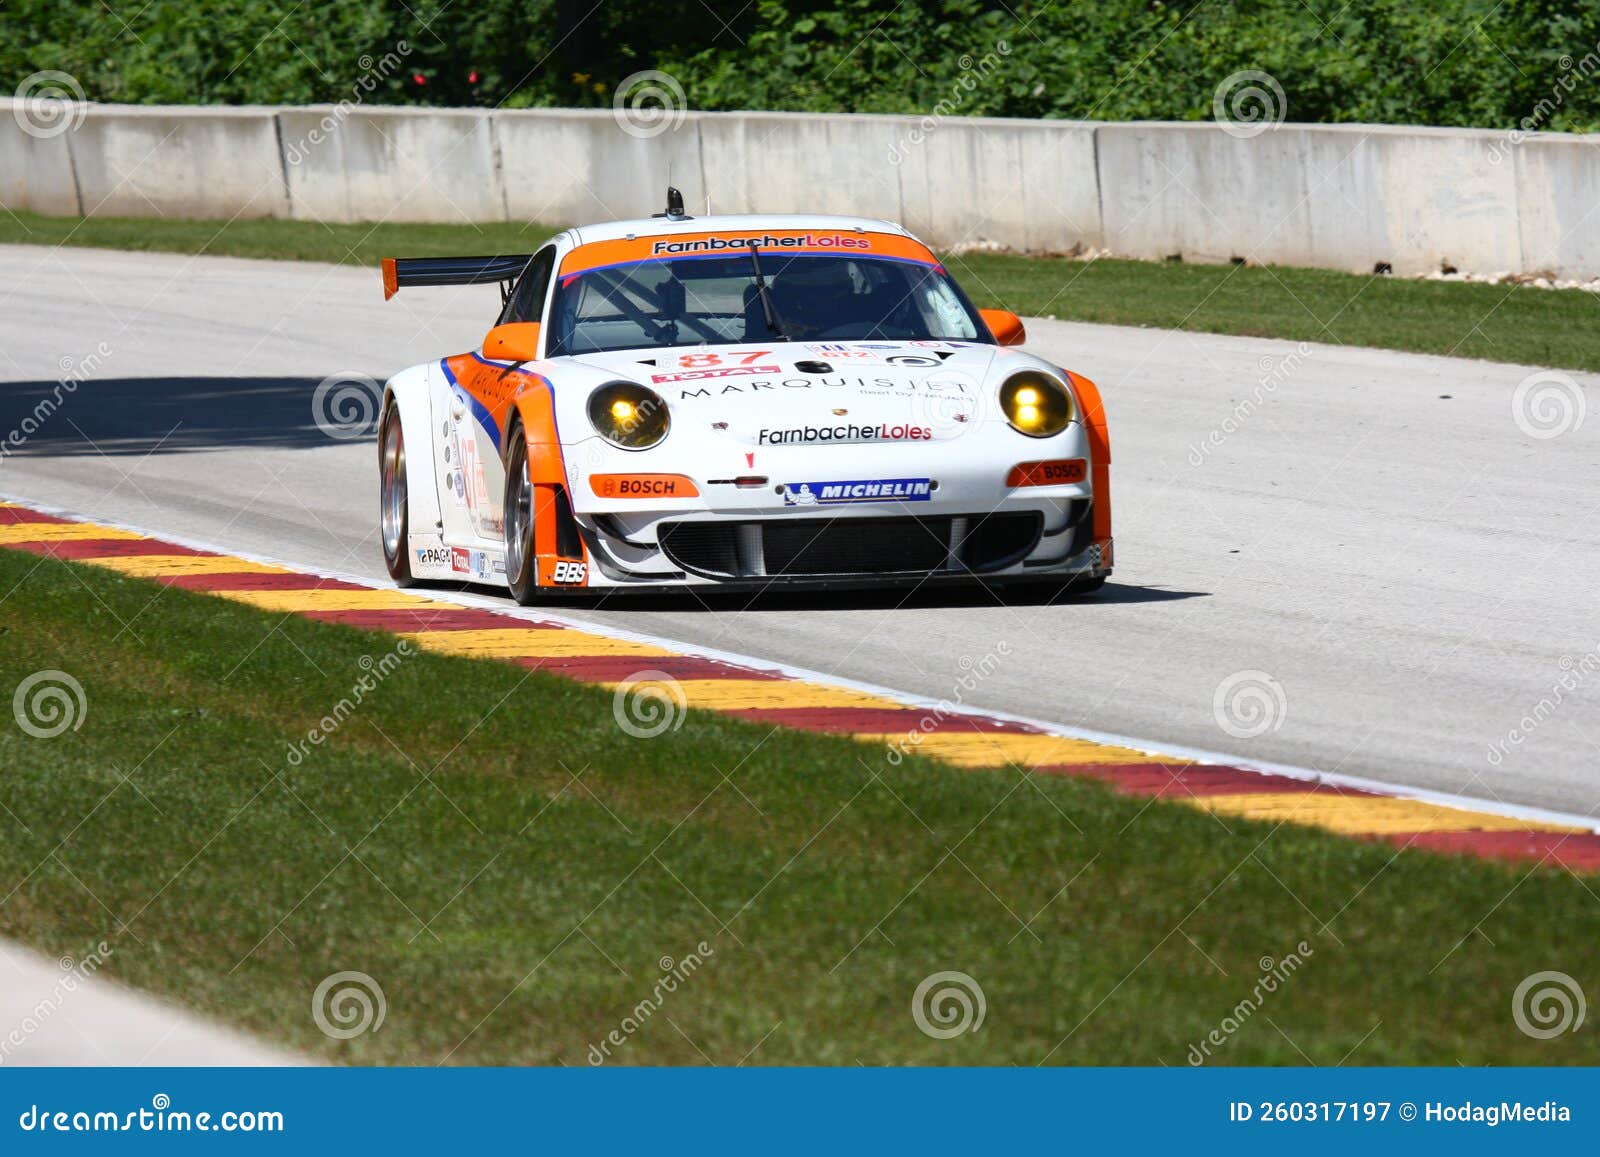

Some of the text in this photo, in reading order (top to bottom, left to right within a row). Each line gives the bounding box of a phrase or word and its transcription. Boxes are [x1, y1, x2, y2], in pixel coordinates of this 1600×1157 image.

[653, 235, 870, 254] FarnbacherLoles
[678, 351, 774, 368] 87
[653, 366, 779, 383] TOTAL
[758, 423, 932, 446] FarnbacherLoles
[619, 480, 675, 494] BOSCH
[820, 482, 930, 498] MICHELIN
[553, 561, 587, 584] BBS
